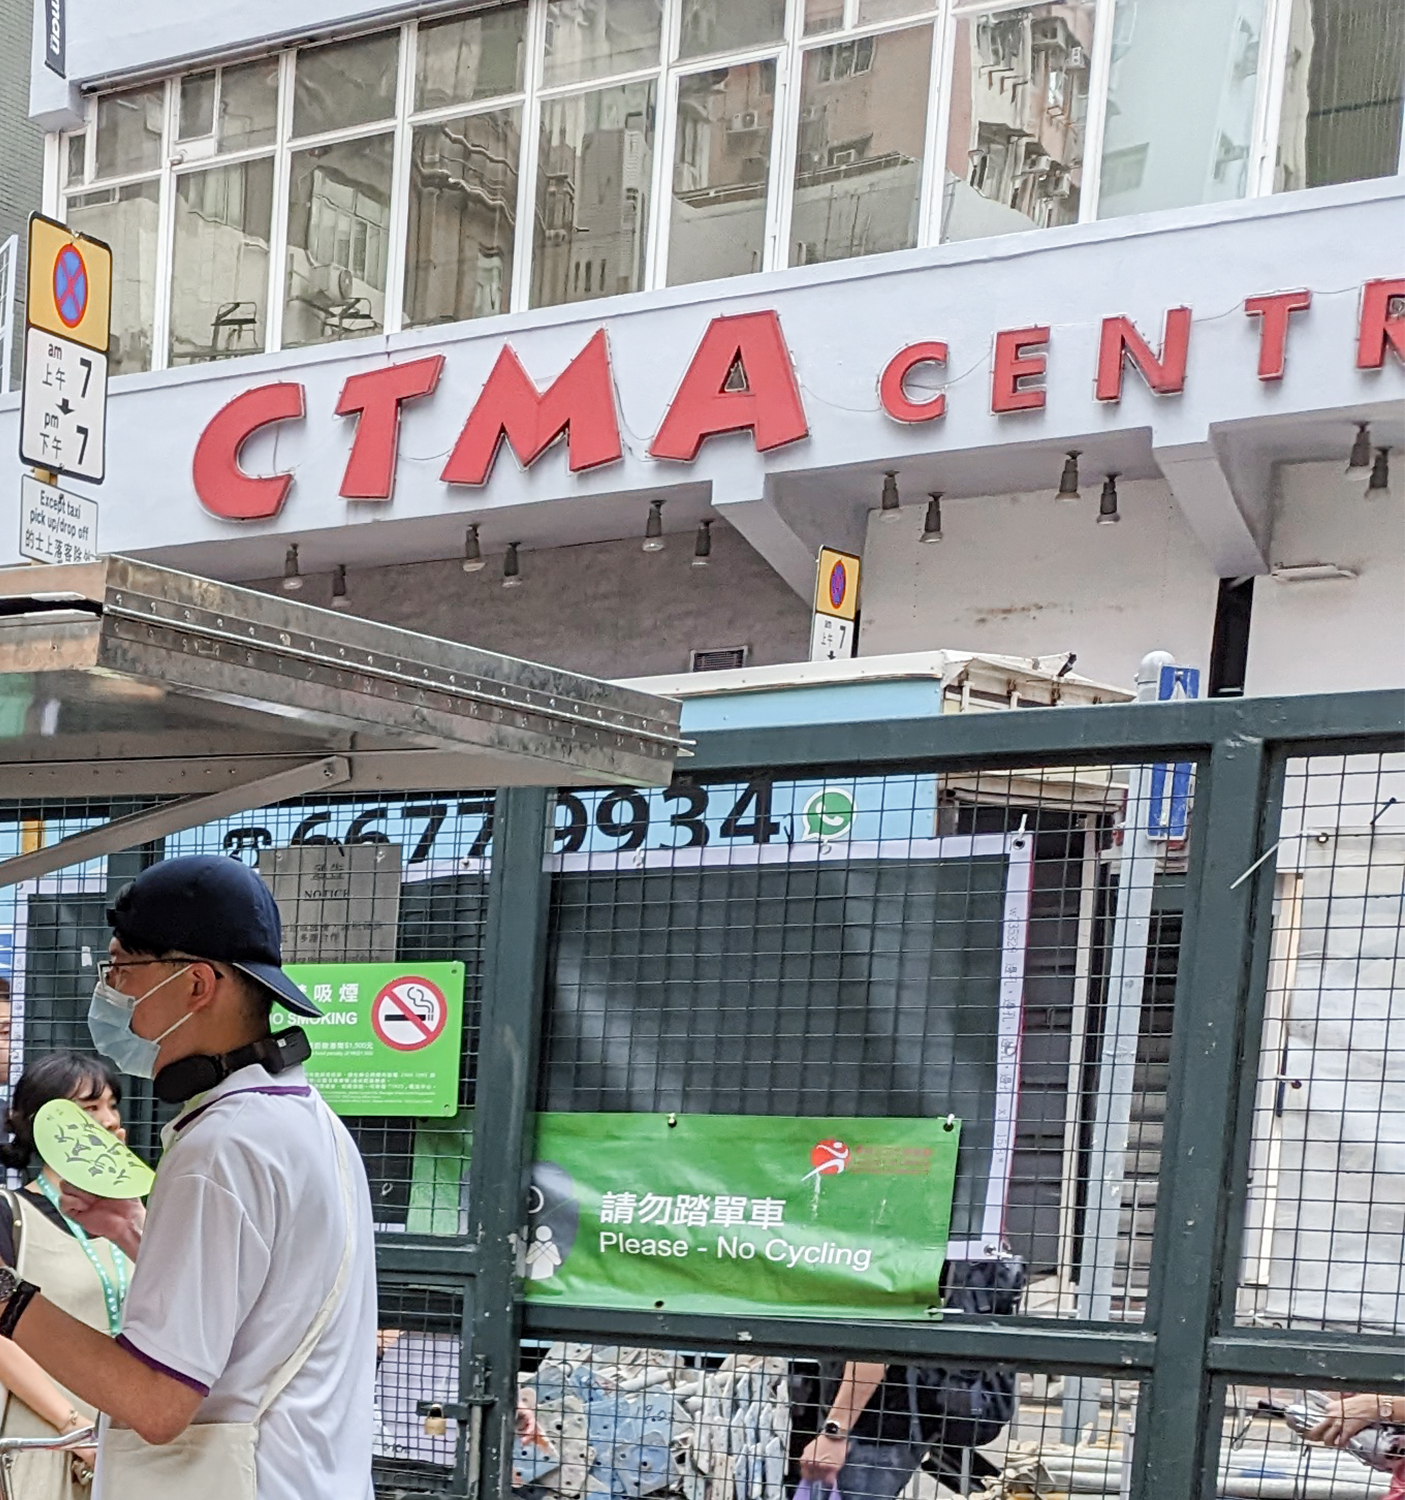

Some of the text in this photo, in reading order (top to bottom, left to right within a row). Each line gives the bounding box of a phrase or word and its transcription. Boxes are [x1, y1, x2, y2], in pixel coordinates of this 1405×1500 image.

[49, 343, 62, 360] am
[42, 363, 66, 391] 上午
[80, 357, 92, 398] 7
[44, 412, 59, 429] pm
[192, 308, 810, 521] CTMA
[40, 432, 62, 459] 下午
[76, 425, 89, 466] 7
[40, 490, 81, 519] Except taxi
[30, 508, 89, 541] pick up/drop off
[839, 625, 846, 649] 7
[304, 889, 349, 899] NOTICE
[287, 1012, 358, 1026] SMOKING
[599, 1191, 787, 1230] 請勿踏單車
[599, 1231, 689, 1257] Please
[717, 1236, 755, 1259] No
[765, 1239, 872, 1271] Cycling
